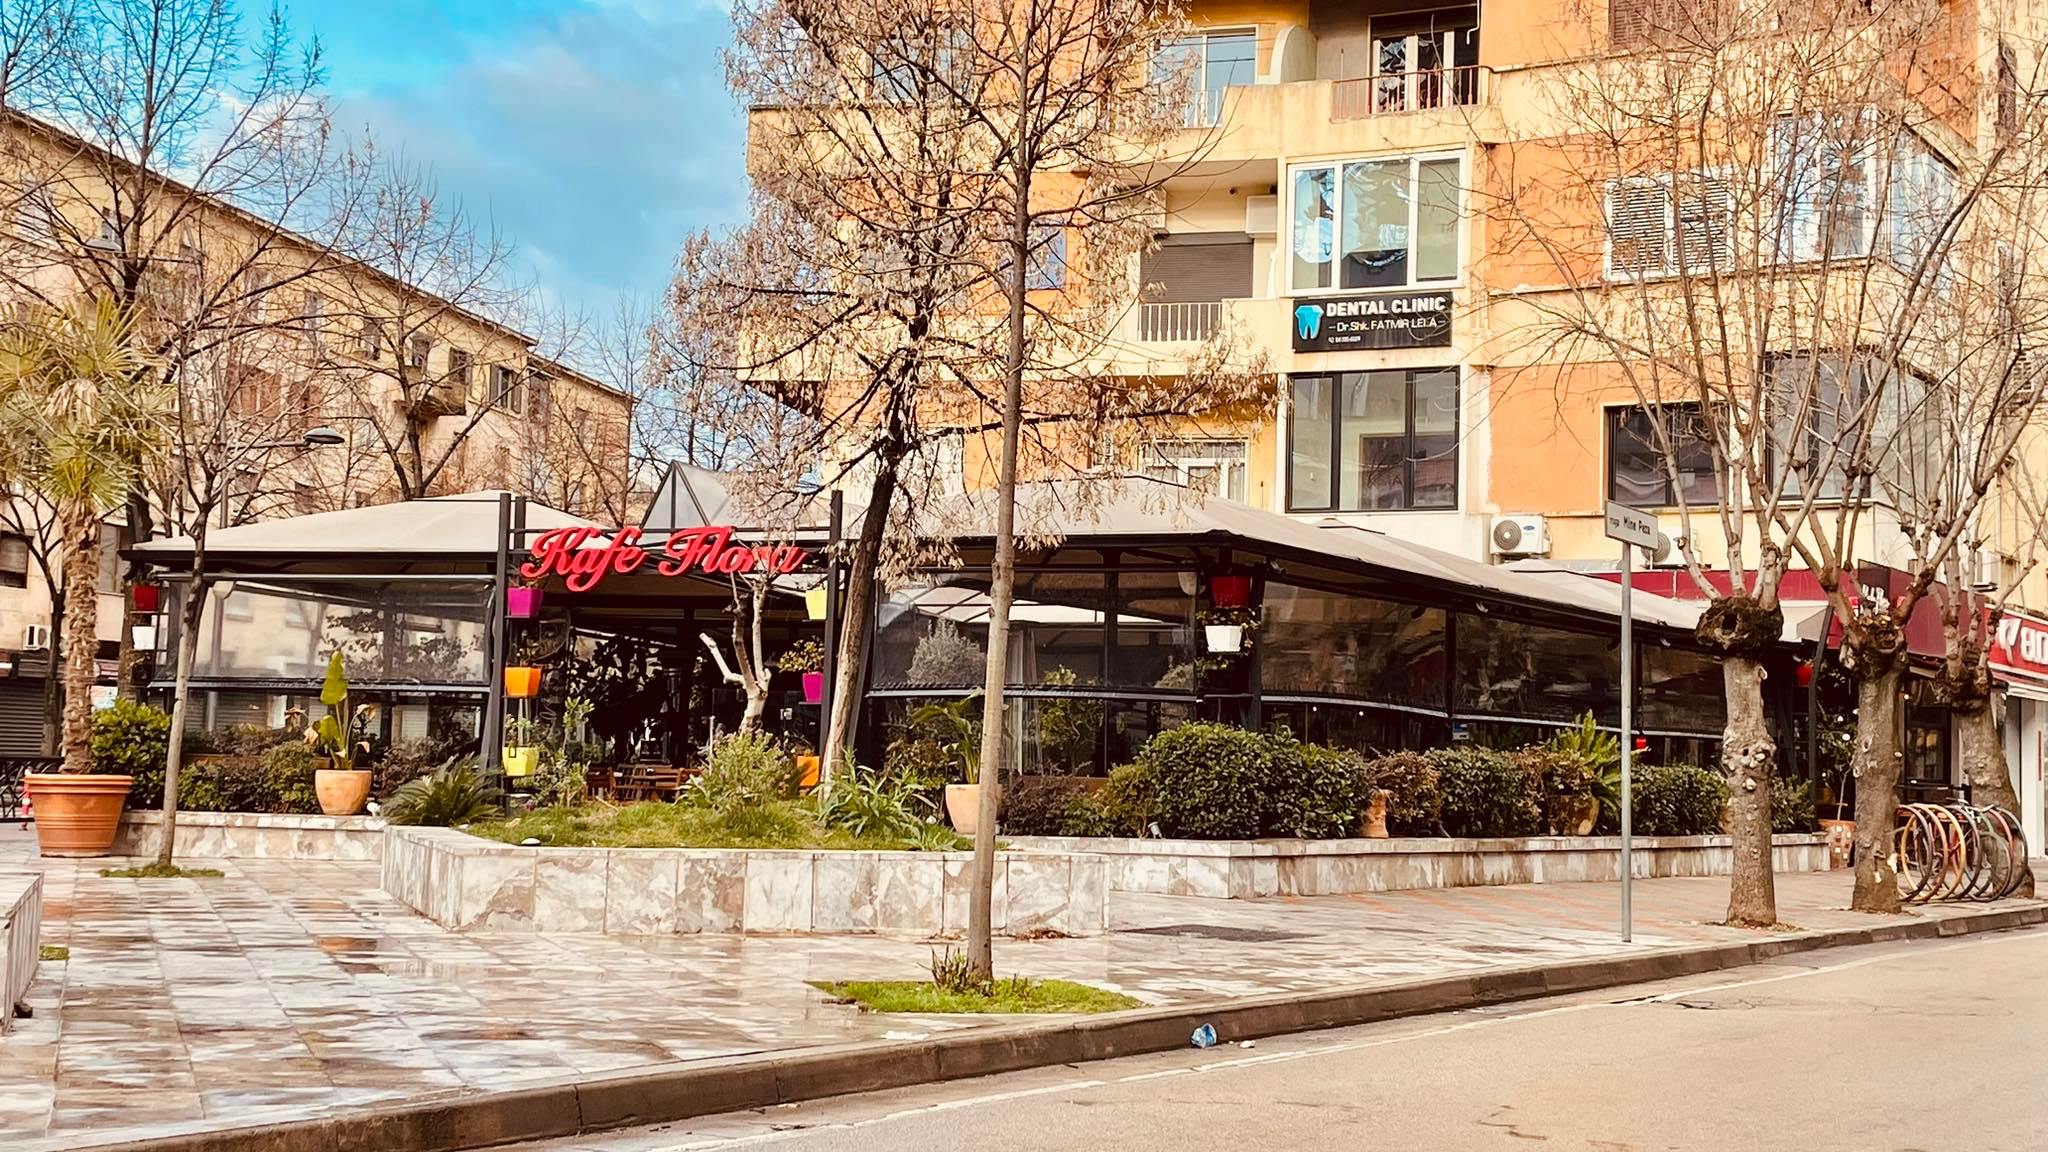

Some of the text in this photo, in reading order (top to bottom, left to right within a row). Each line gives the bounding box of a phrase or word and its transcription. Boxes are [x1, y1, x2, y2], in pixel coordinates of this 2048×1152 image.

[1326, 296, 1446, 317] DENTAL CLINIC
[1371, 318, 1409, 330] FATMIR
[520, 525, 809, 592] Kafe Flora
